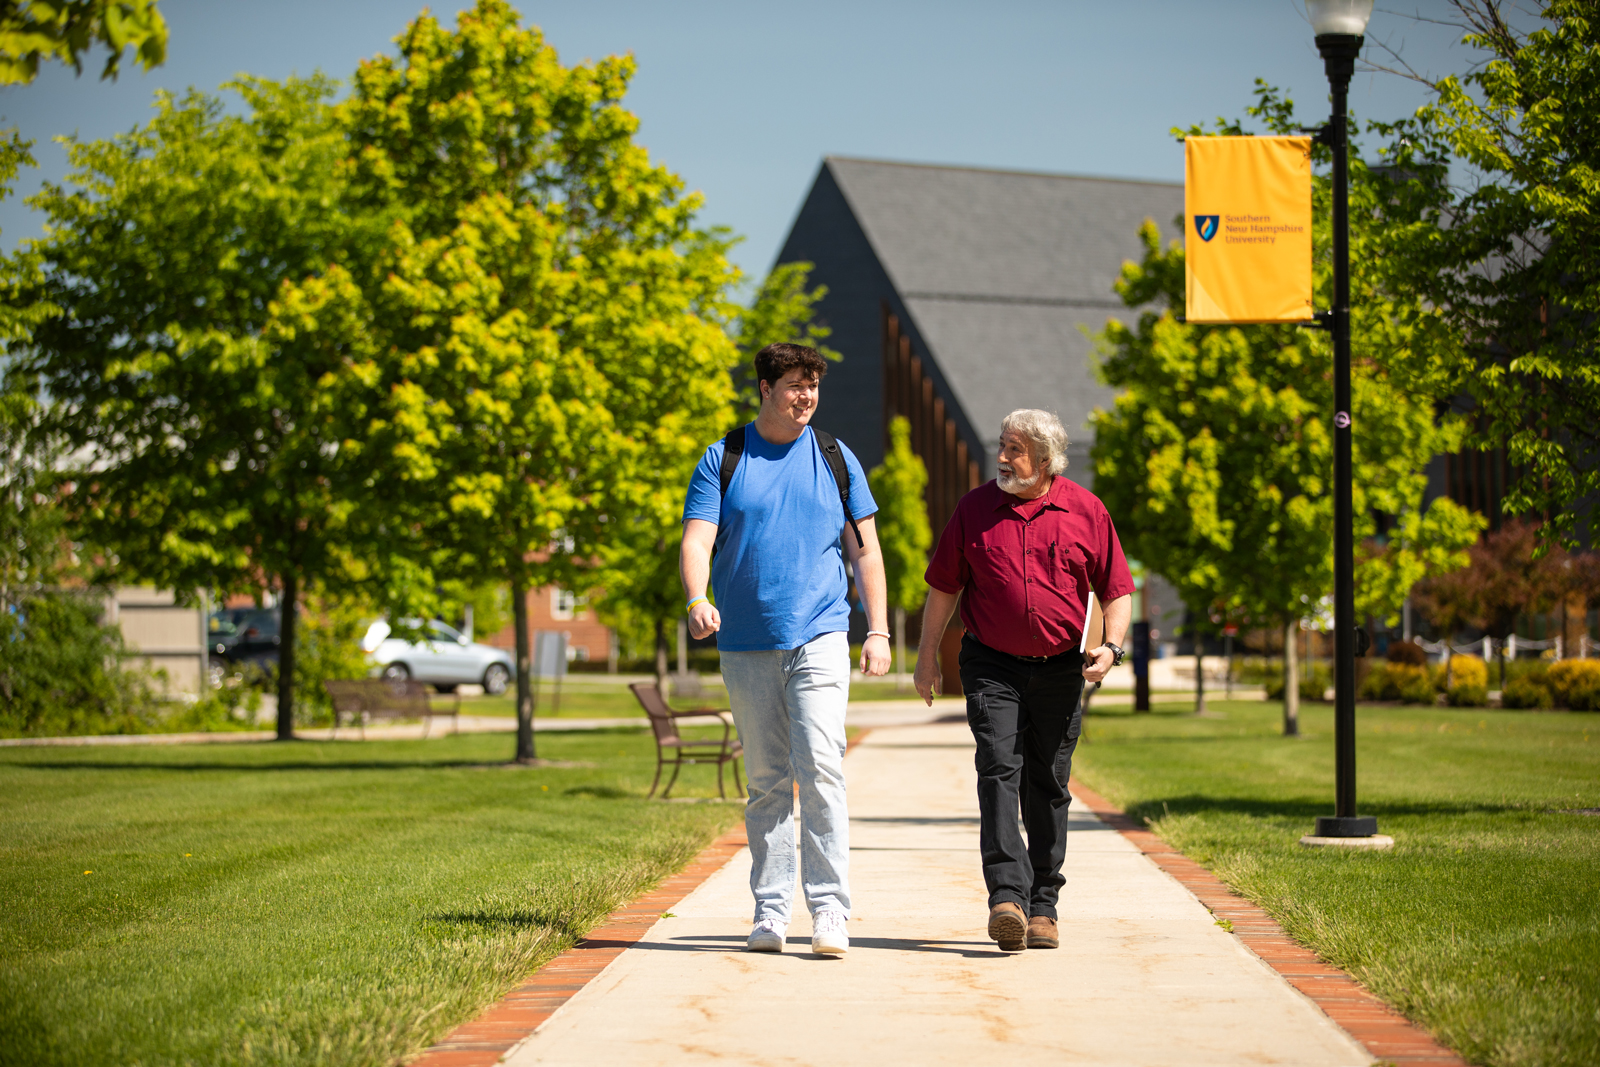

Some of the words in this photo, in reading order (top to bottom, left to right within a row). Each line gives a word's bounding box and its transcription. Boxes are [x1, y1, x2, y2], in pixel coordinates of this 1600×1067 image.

[1225, 214, 1271, 223] Southern
[1225, 225, 1248, 233] New
[1250, 224, 1304, 235] Hampshire
[1225, 235, 1276, 245] University
